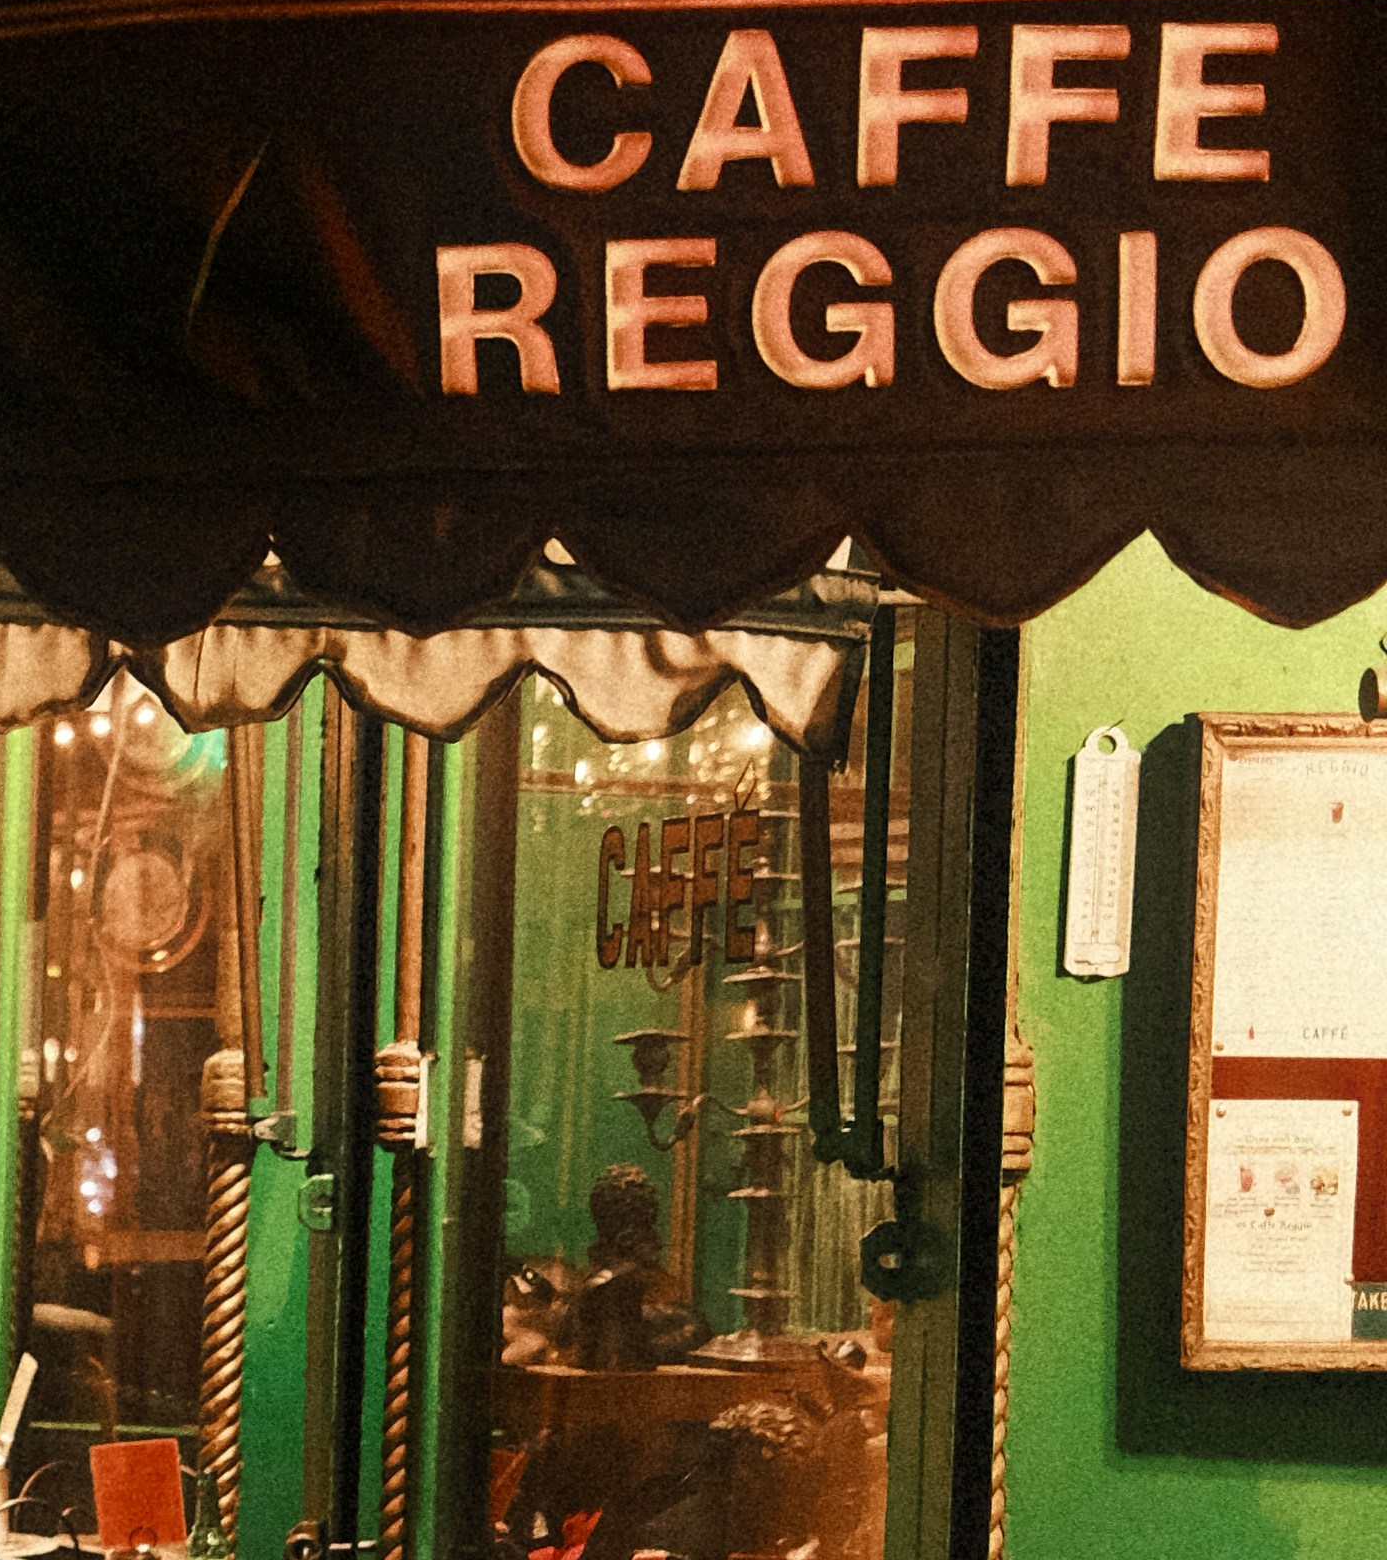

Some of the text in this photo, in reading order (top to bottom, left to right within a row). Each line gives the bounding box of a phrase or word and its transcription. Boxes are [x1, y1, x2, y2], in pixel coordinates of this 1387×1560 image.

[510, 20, 1281, 195] CAFFE
[433, 225, 1349, 397] REGGIO
[595, 808, 760, 970] CAFFE
